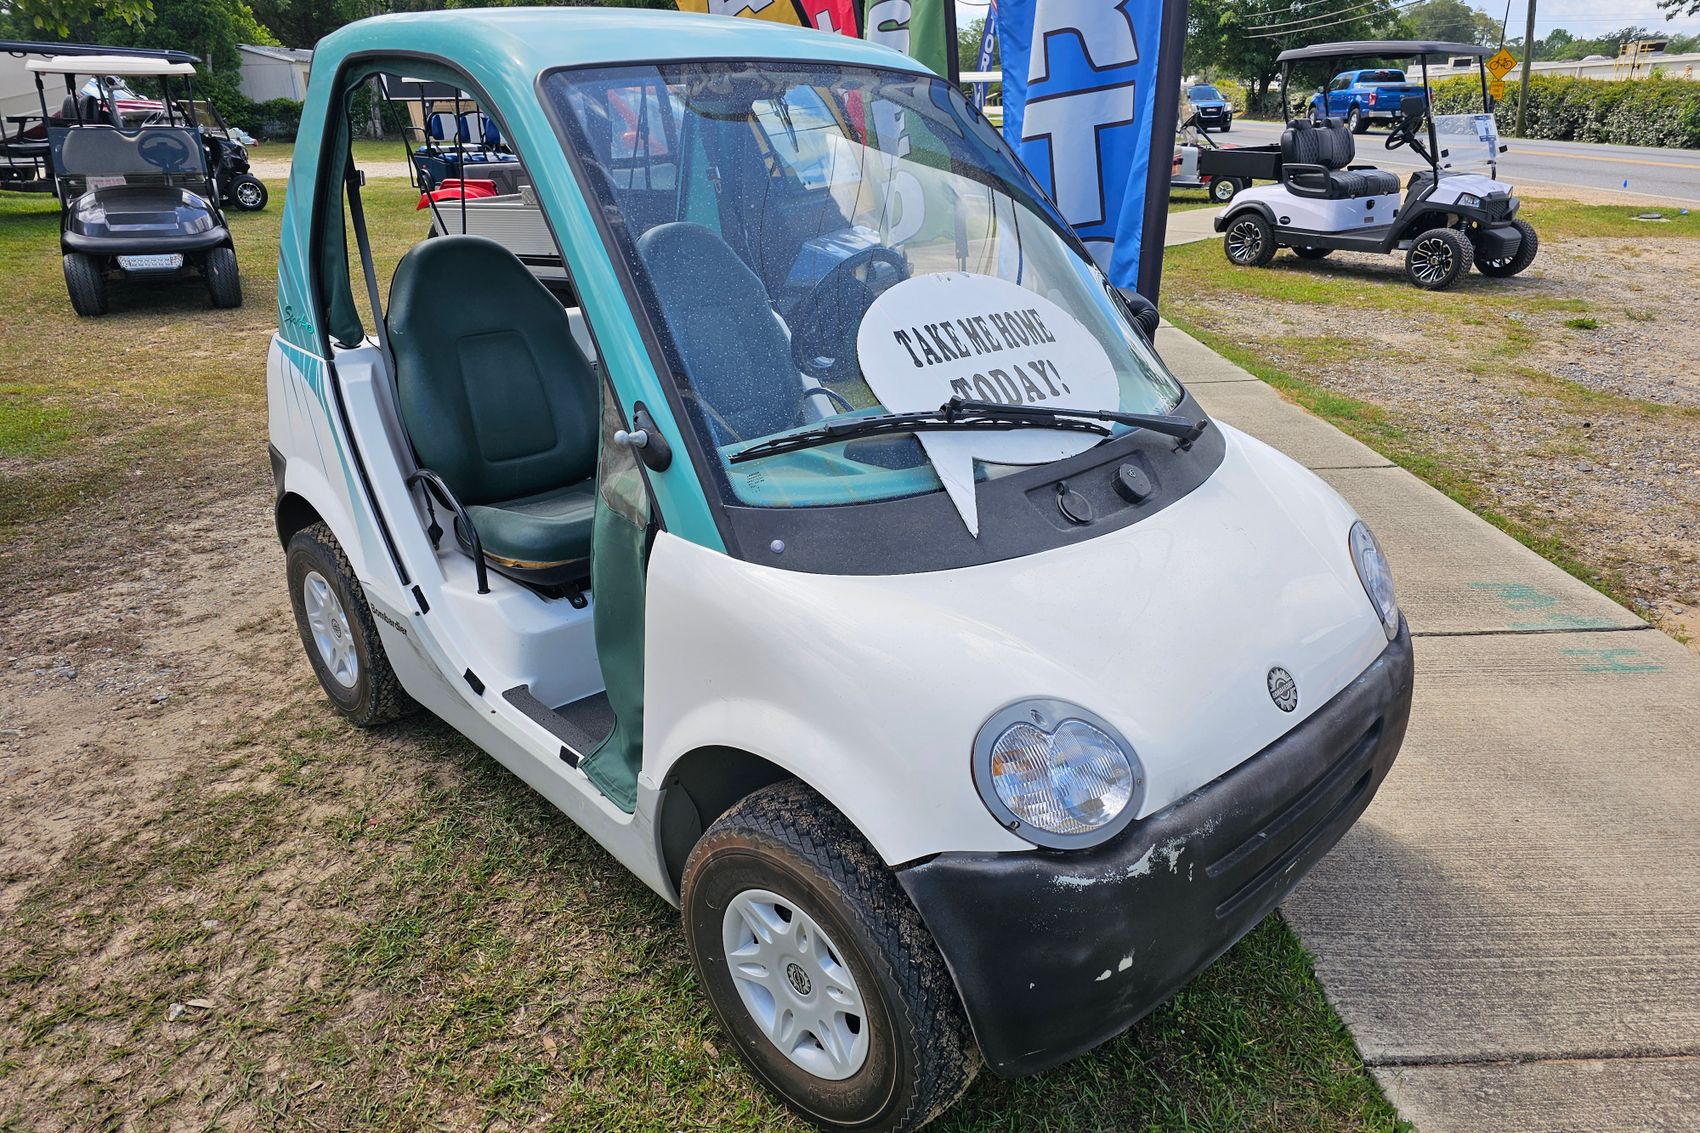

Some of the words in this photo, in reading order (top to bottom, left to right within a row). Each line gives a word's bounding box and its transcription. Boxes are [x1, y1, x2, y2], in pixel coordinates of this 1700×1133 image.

[893, 320, 971, 368] TAKE
[957, 315, 1003, 356] ME
[988, 308, 1057, 349] HOME
[950, 359, 1071, 405] TODAY!
